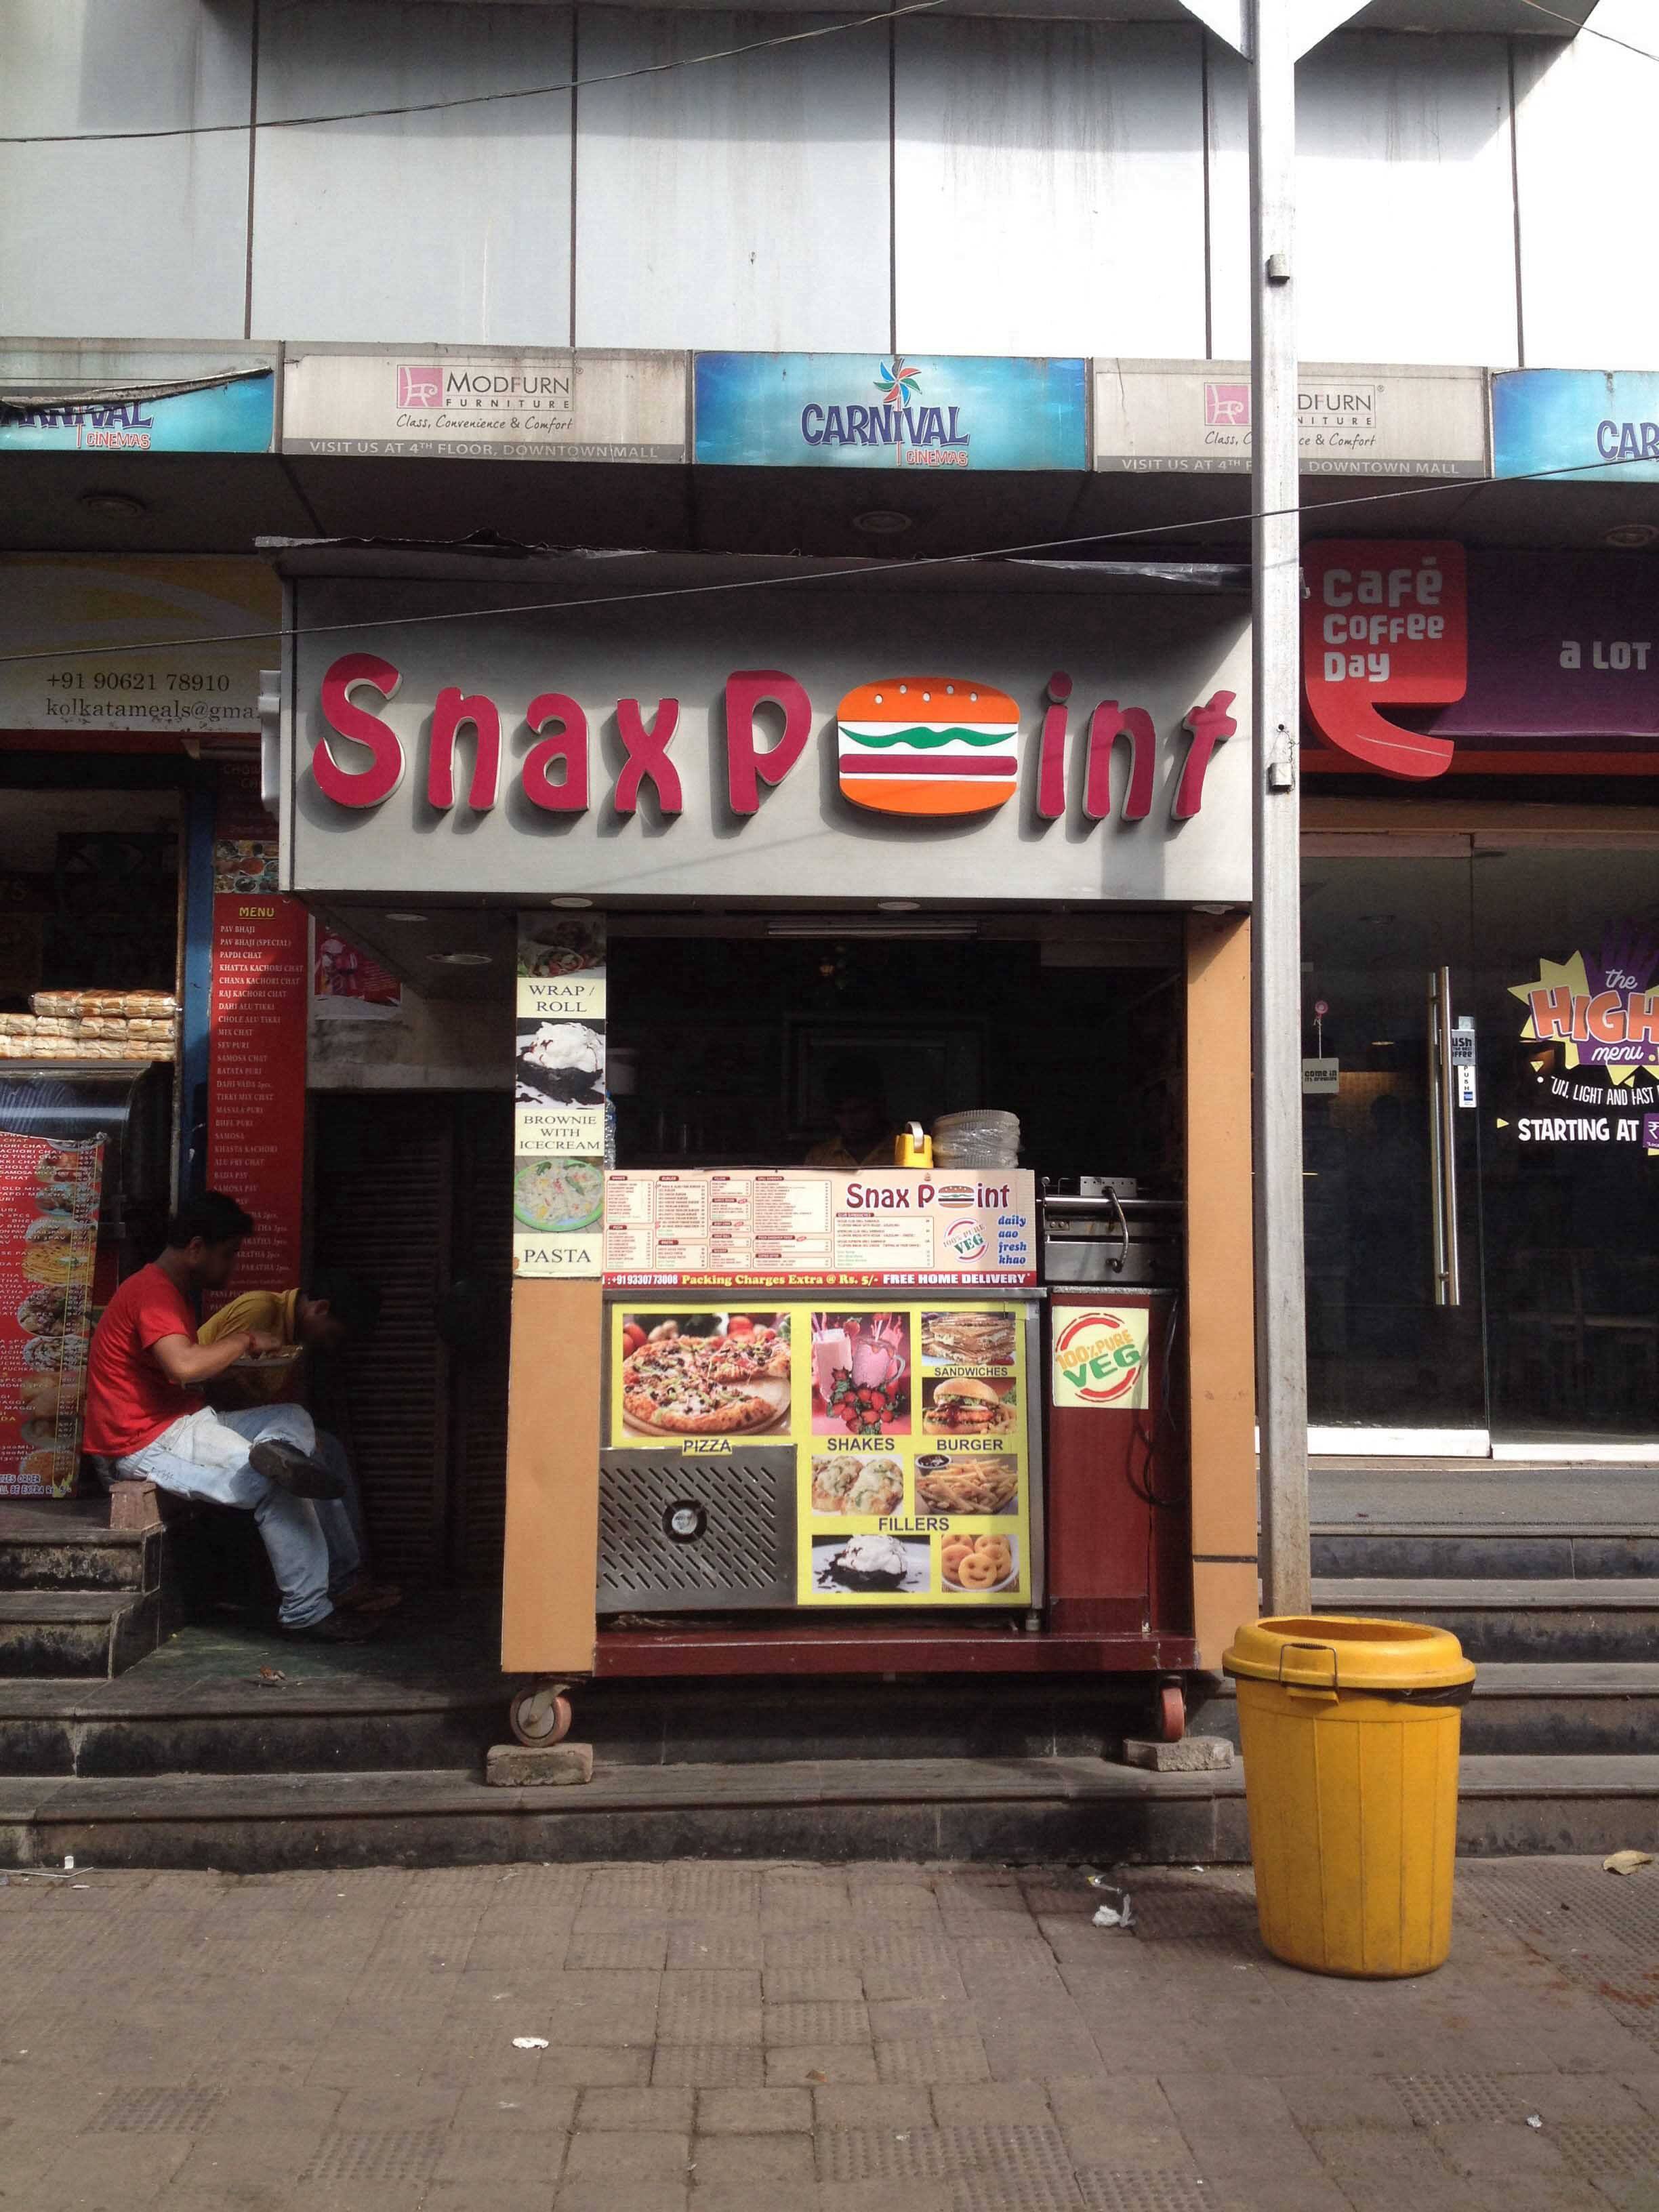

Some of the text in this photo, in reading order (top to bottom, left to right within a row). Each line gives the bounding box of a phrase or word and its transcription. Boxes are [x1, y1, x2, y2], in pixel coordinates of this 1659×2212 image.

[446, 370, 569, 394] MODFURN
[445, 398, 570, 409] FURNITURE
[1298, 394, 1371, 411] DFURN
[396, 413, 573, 432] Class, Convenience & Comfort
[800, 403, 970, 446] CARNIVAL
[1298, 416, 1372, 426] NITURE
[87, 430, 151, 449] CINEMAS
[1204, 430, 1239, 445] Class,
[1315, 434, 1325, 446] &
[1329, 432, 1377, 449] Comfort
[1597, 418, 1659, 462] CAR
[310, 441, 354, 453] VISIT
[357, 441, 380, 453] US
[384, 442, 405, 454] AT
[438, 443, 497, 456] FLOOR,
[504, 444, 608, 457] DOWNTOWN
[613, 445, 658, 458] MALL
[906, 448, 968, 467] CINEMAS
[1122, 458, 1165, 471] VISIT
[1169, 459, 1189, 471] US
[1194, 459, 1213, 470] AT
[1309, 460, 1412, 474] DOWNTOWN
[1416, 462, 1459, 475] MALL
[1323, 556, 1443, 609] Café
[1323, 613, 1444, 645] Coffee
[1324, 652, 1390, 683] Day
[46, 672, 230, 693] +91 90621 78910
[312, 651, 686, 816] Snax
[239, 906, 275, 918] MENU
[1605, 968, 1638, 990] the
[529, 984, 586, 996] WRAP
[536, 1000, 588, 1013] ROLL
[1529, 986, 1659, 1044] HIGH
[1591, 1046, 1644, 1066] menu
[1572, 1084, 1604, 1105] LIGHT
[1606, 1089, 1628, 1106] AND
[523, 1114, 597, 1126] BROWNIE
[540, 1127, 580, 1139] WITH
[1517, 1118, 1610, 1142] STARTING
[1616, 1119, 1640, 1142] AT
[519, 1140, 600, 1151] ICECREAM
[846, 1183, 910, 1209] Snax
[998, 1214, 1027, 1228] daily
[953, 1233, 985, 1254] VEG
[998, 1241, 1027, 1254] fresh
[523, 1248, 592, 1264] PASTA
[998, 1254, 1027, 1265] khao
[681, 1274, 733, 1286] Packing
[735, 1274, 785, 1286] Charges
[787, 1274, 823, 1286] Extra
[825, 1274, 837, 1285] @
[839, 1273, 858, 1285] Rs.
[882, 1273, 916, 1284] FREE
[918, 1273, 959, 1284] HOME
[1094, 1328, 1134, 1353] PURE
[934, 1366, 1008, 1377] SANDWICHES
[1063, 1343, 1142, 1388] VEG
[682, 1437, 1004, 1454] PIZZA SHAKES BURGER
[878, 1516, 949, 1532] FILLERS
